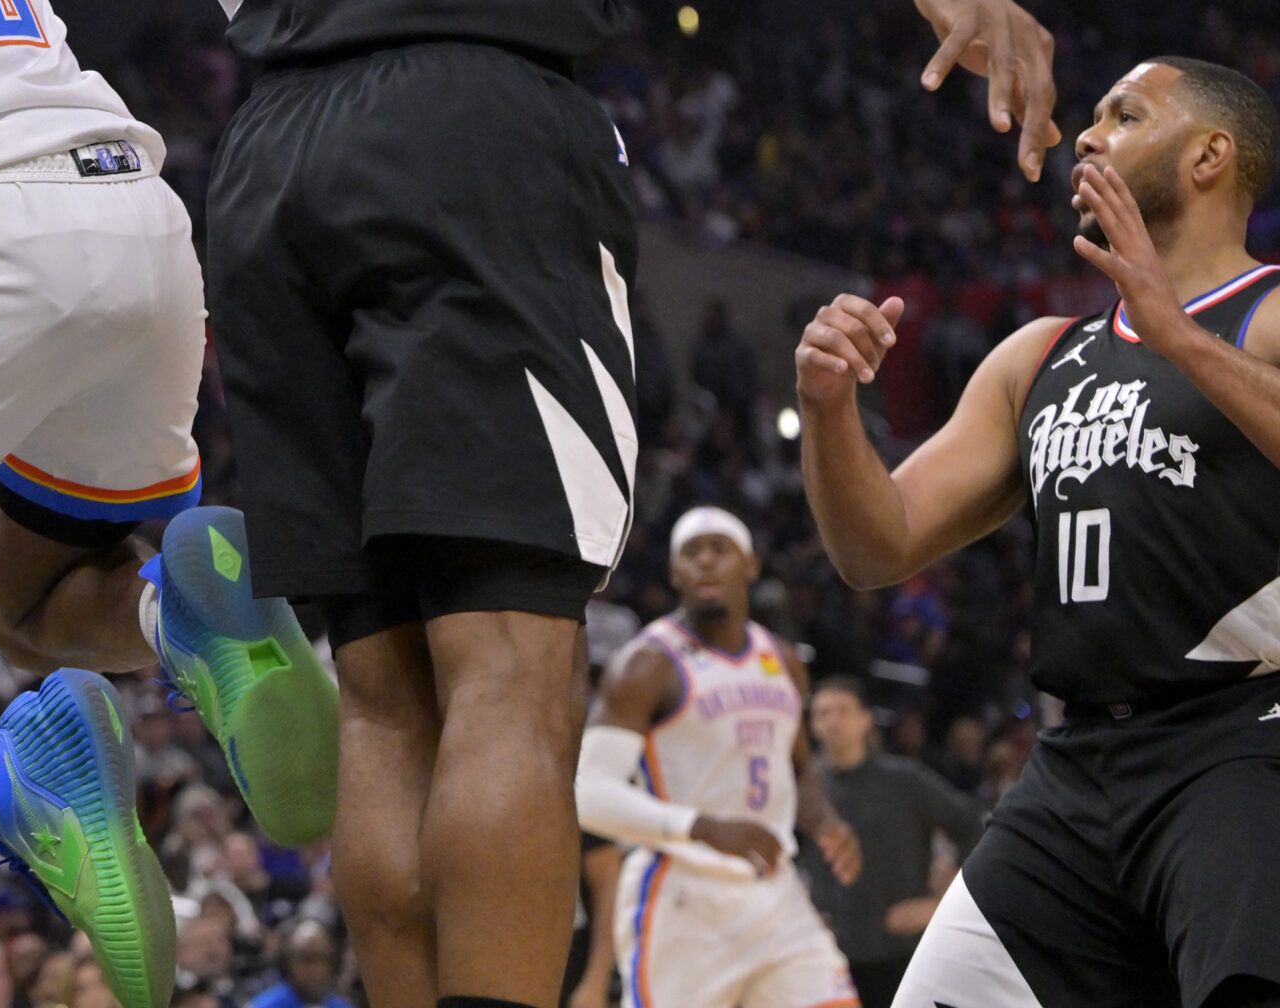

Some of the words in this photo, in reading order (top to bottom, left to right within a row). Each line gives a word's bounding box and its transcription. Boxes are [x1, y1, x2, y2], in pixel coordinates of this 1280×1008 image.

[1051, 373, 1147, 426] Los
[1029, 398, 1200, 507] Angeles
[1058, 508, 1111, 604] 10
[747, 755, 770, 811] 5
